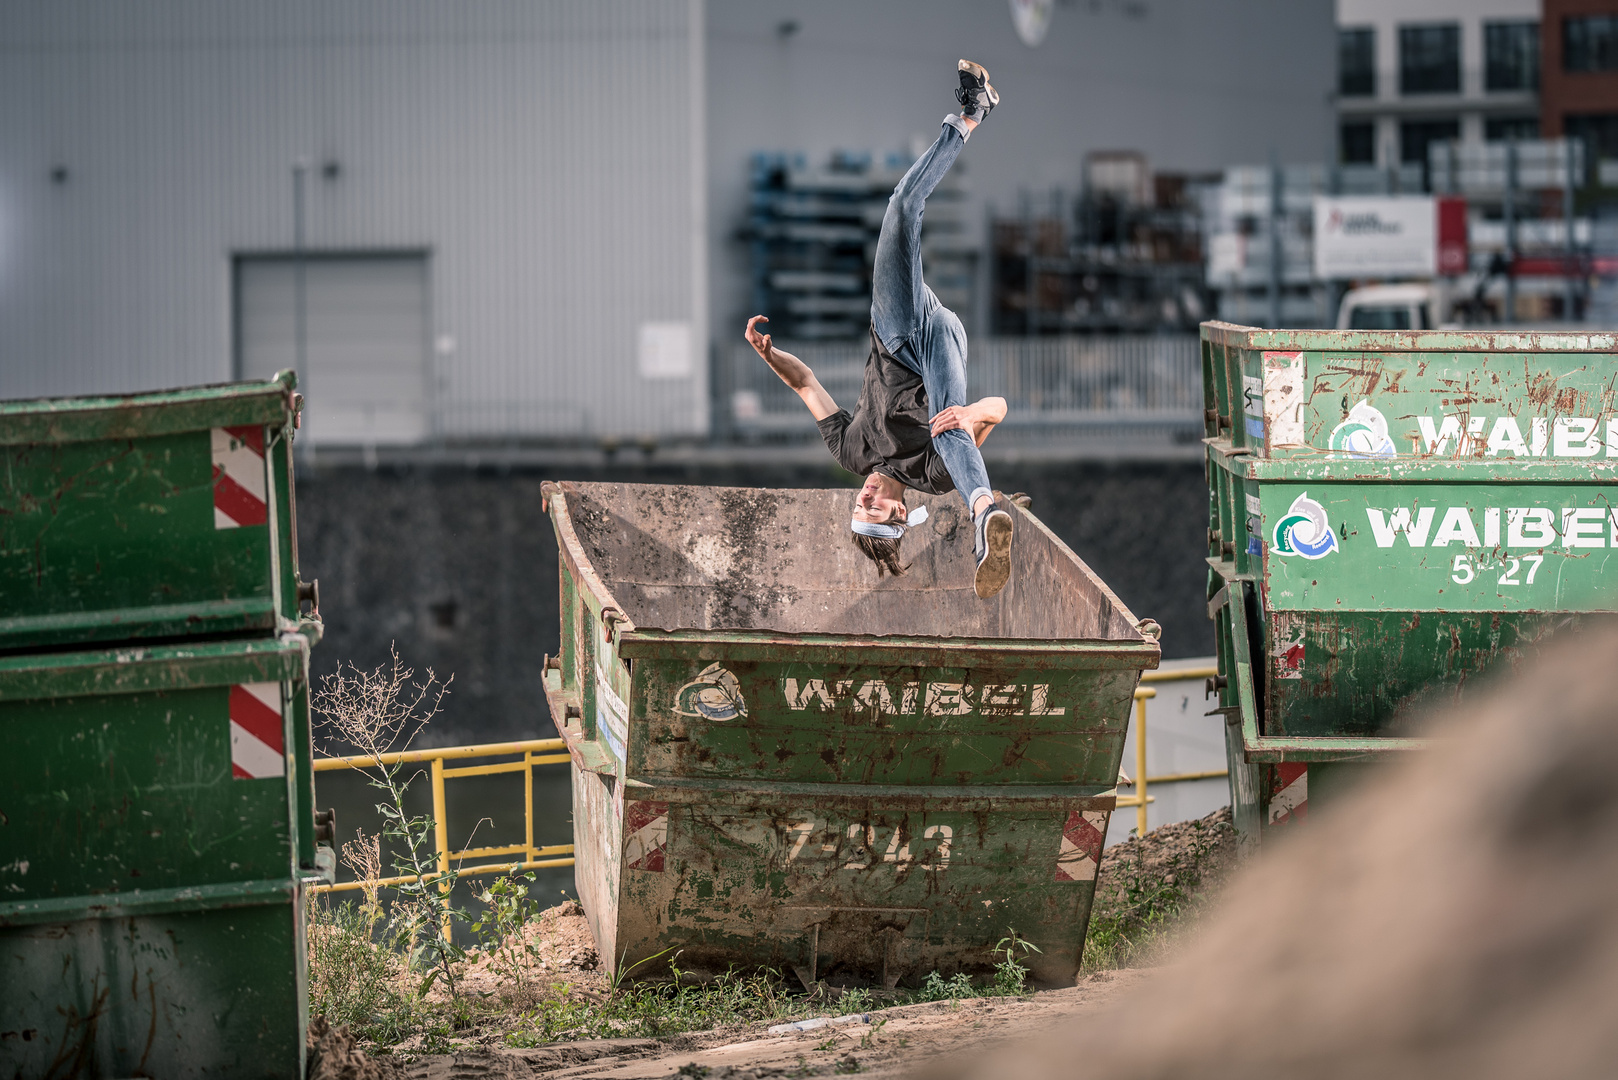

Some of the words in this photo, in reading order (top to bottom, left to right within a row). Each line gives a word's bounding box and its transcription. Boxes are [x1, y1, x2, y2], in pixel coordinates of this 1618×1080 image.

[1417, 416, 1618, 457] WAIB
[1282, 525, 1291, 550] Recycling
[784, 677, 1066, 716] WAIBEL
